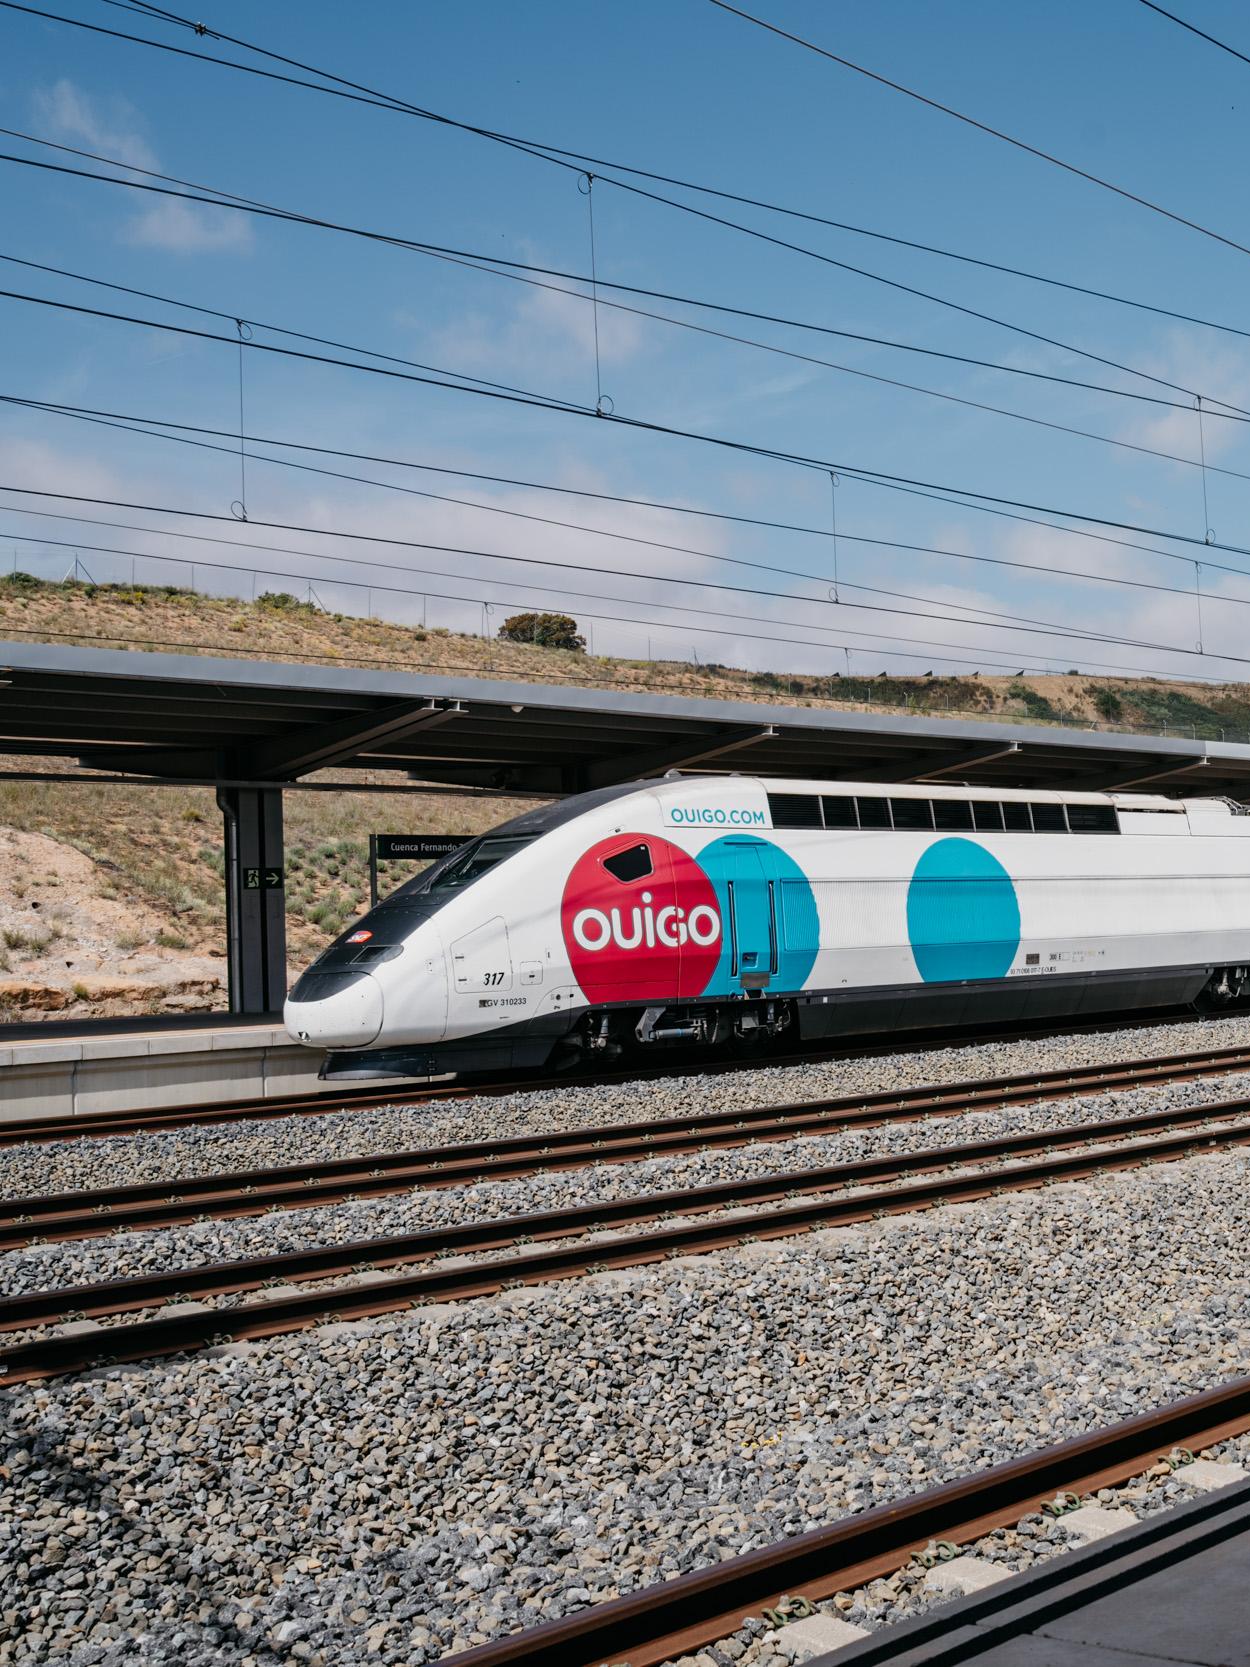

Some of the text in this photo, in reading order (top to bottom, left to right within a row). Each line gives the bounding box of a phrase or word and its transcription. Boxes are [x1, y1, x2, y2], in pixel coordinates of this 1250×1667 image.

[671, 808, 765, 824] OUIGO.COM
[390, 842, 419, 852] Cuenca
[420, 842, 457, 852] Fernando
[483, 972, 505, 986] 317
[500, 997, 527, 1006] 310233
